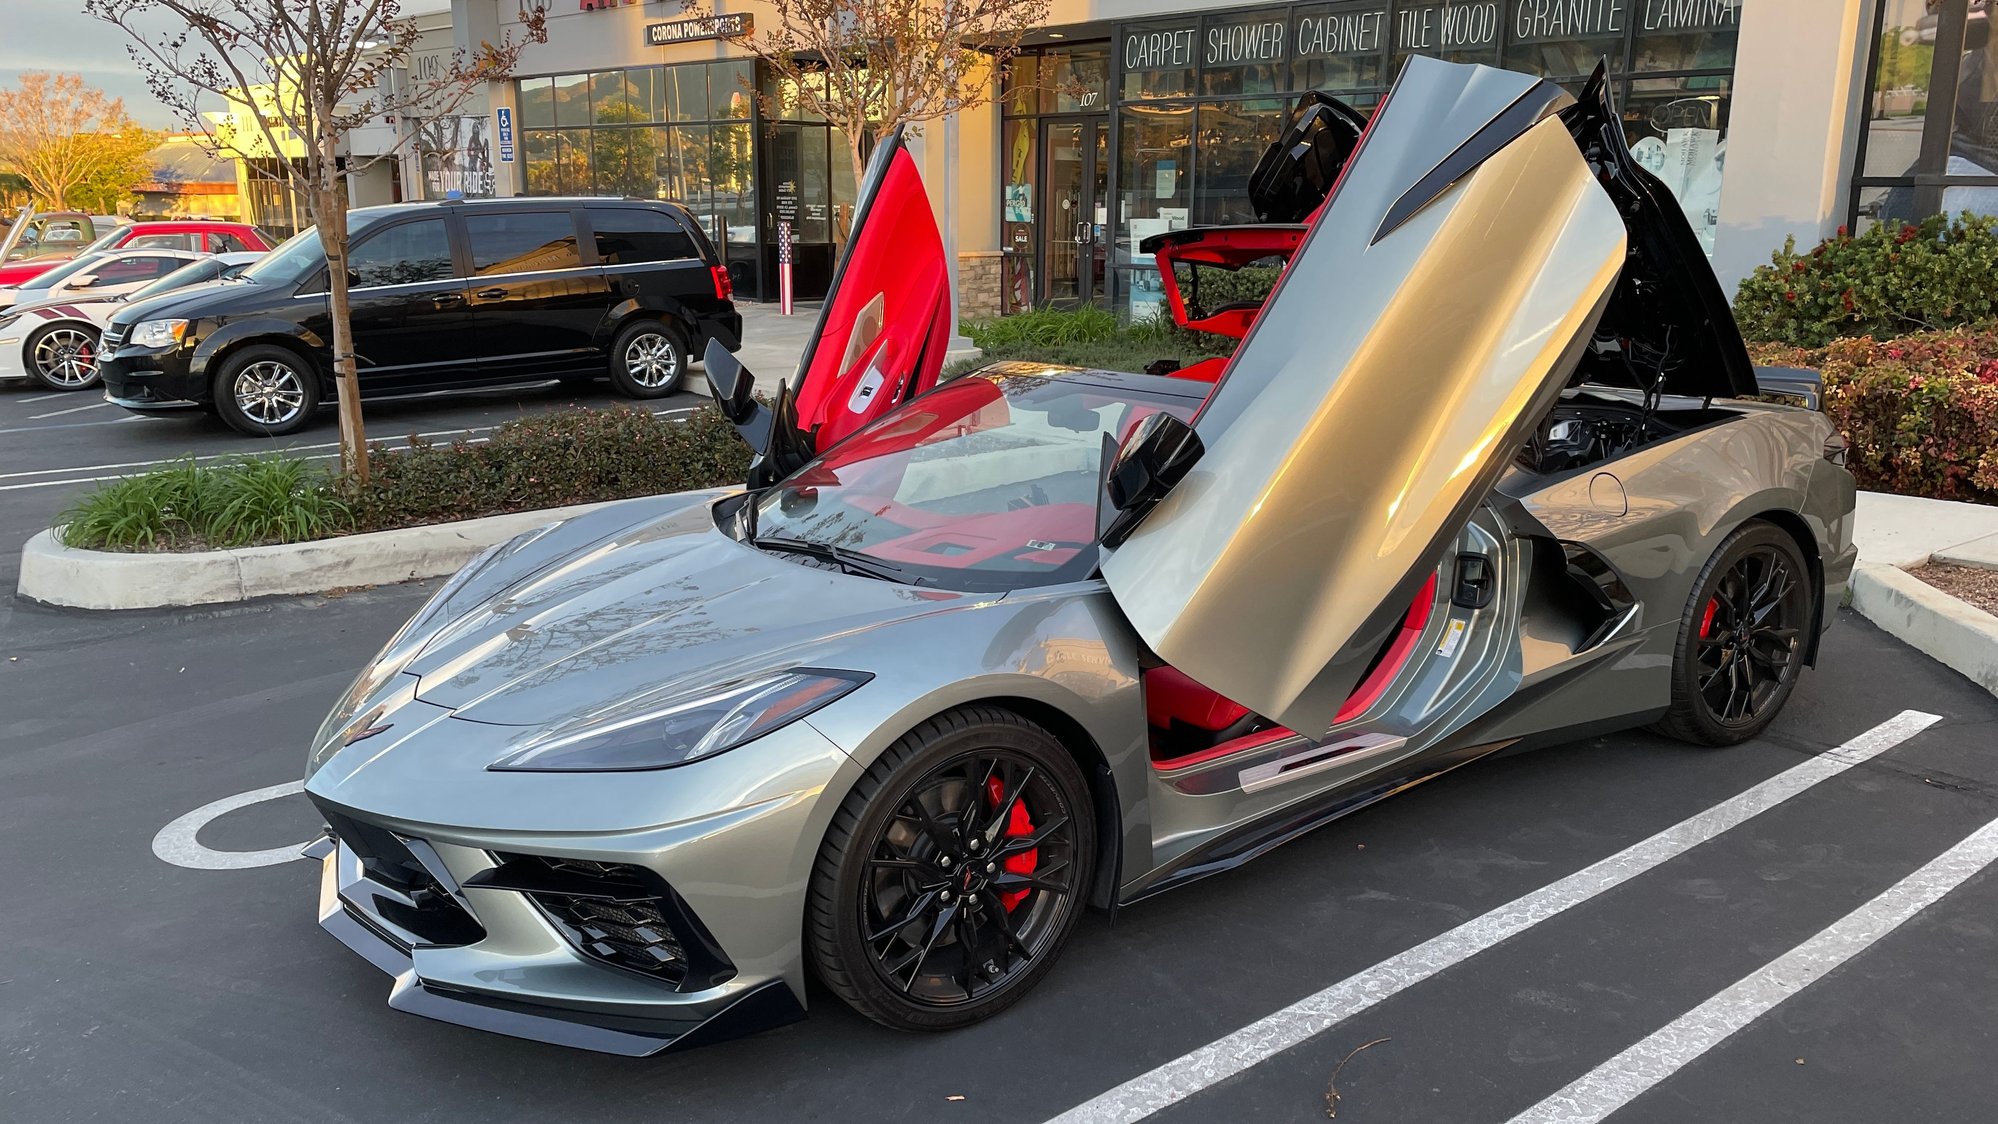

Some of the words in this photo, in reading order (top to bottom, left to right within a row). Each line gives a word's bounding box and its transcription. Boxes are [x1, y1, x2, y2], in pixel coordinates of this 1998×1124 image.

[652, 23, 683, 42] CORONA
[1125, 29, 1196, 69] CARPET
[1206, 22, 1284, 64] SHOWER
[1298, 11, 1385, 55] CABINET
[1398, 8, 1433, 49] TILE
[1440, 2, 1497, 46] WOOD
[1515, 0, 1623, 40] GRANITE
[417, 55, 440, 80] 109
[1079, 91, 1099, 107] 107
[1652, 104, 1709, 127] OPEN
[440, 171, 463, 192] YOUR
[463, 170, 484, 194] RIDE
[1015, 235, 1028, 243] SALE
